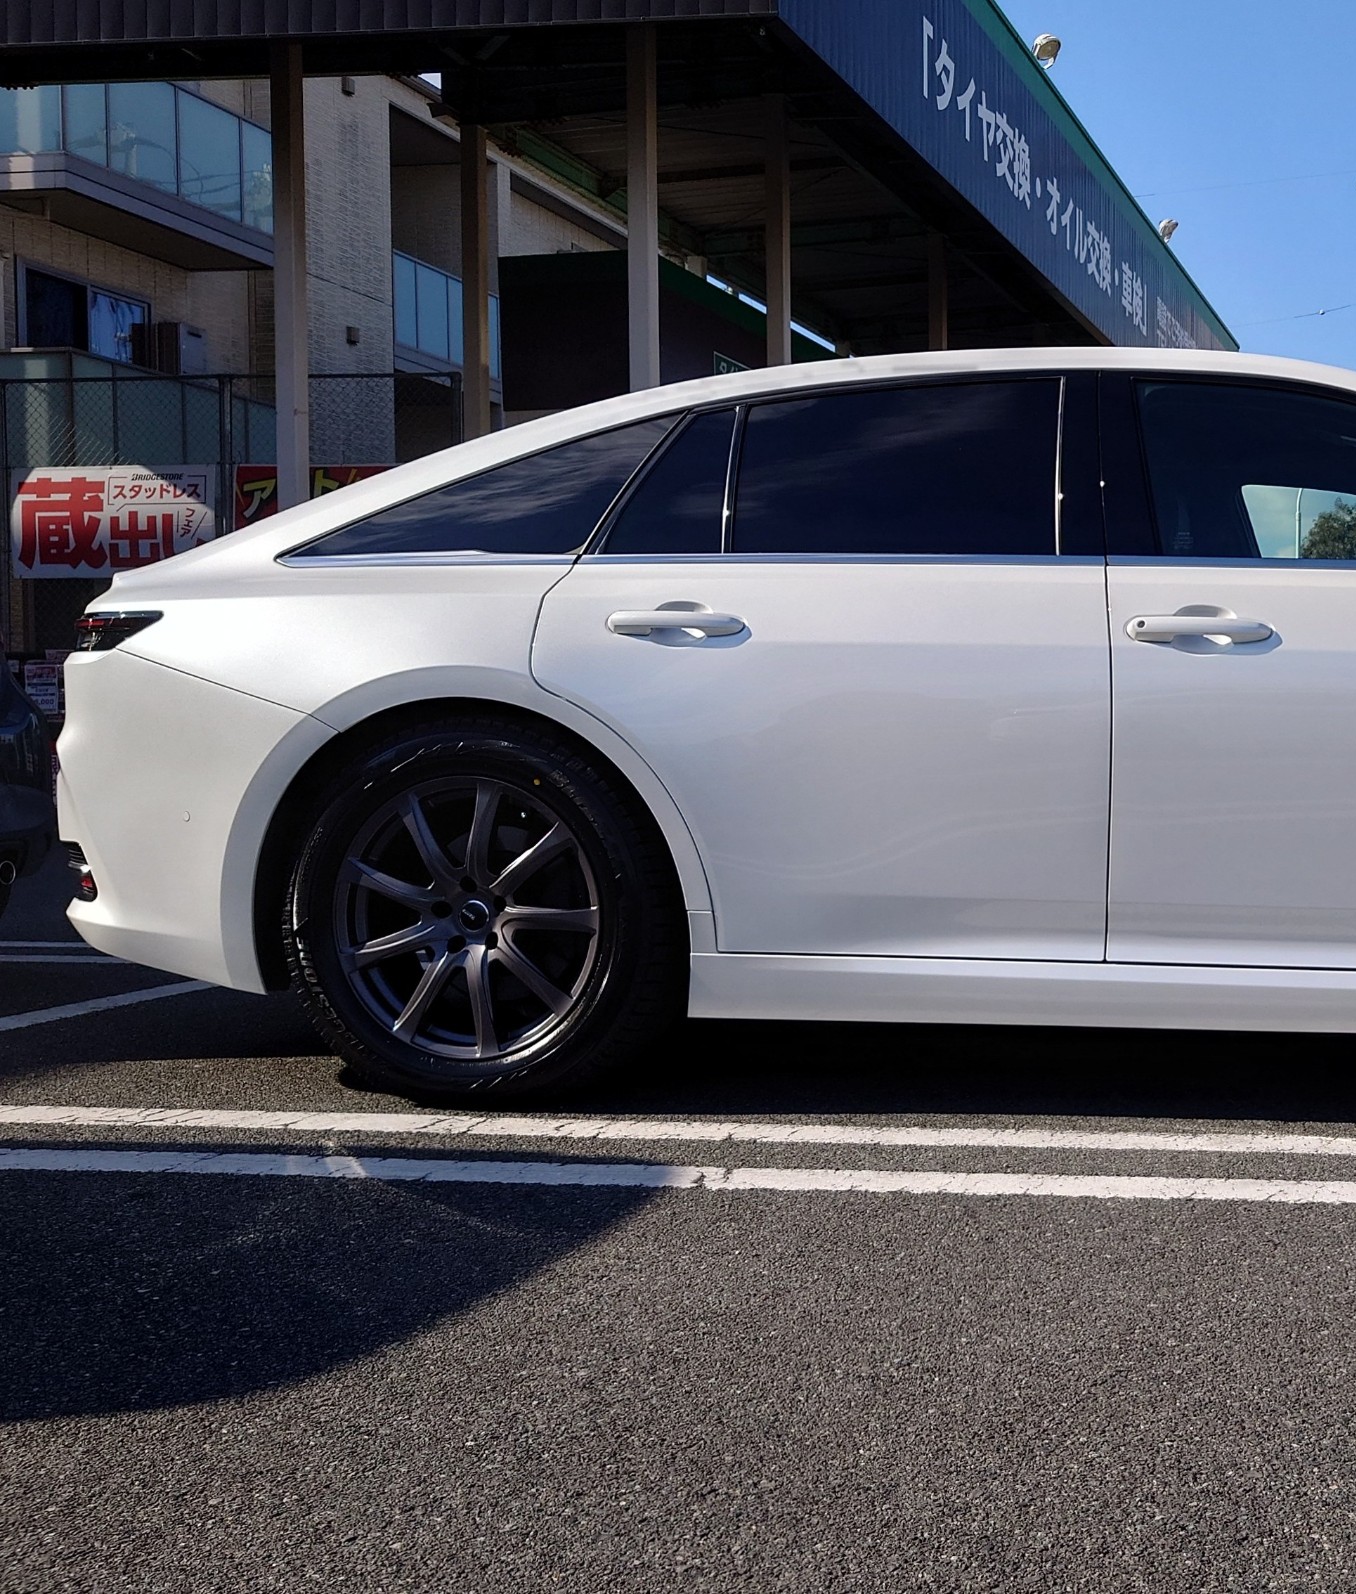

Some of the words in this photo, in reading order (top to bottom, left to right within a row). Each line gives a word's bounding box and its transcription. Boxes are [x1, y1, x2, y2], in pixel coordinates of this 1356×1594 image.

[131, 473, 185, 481] BRIDGESTONE
[113, 483, 201, 499] スタッドレス
